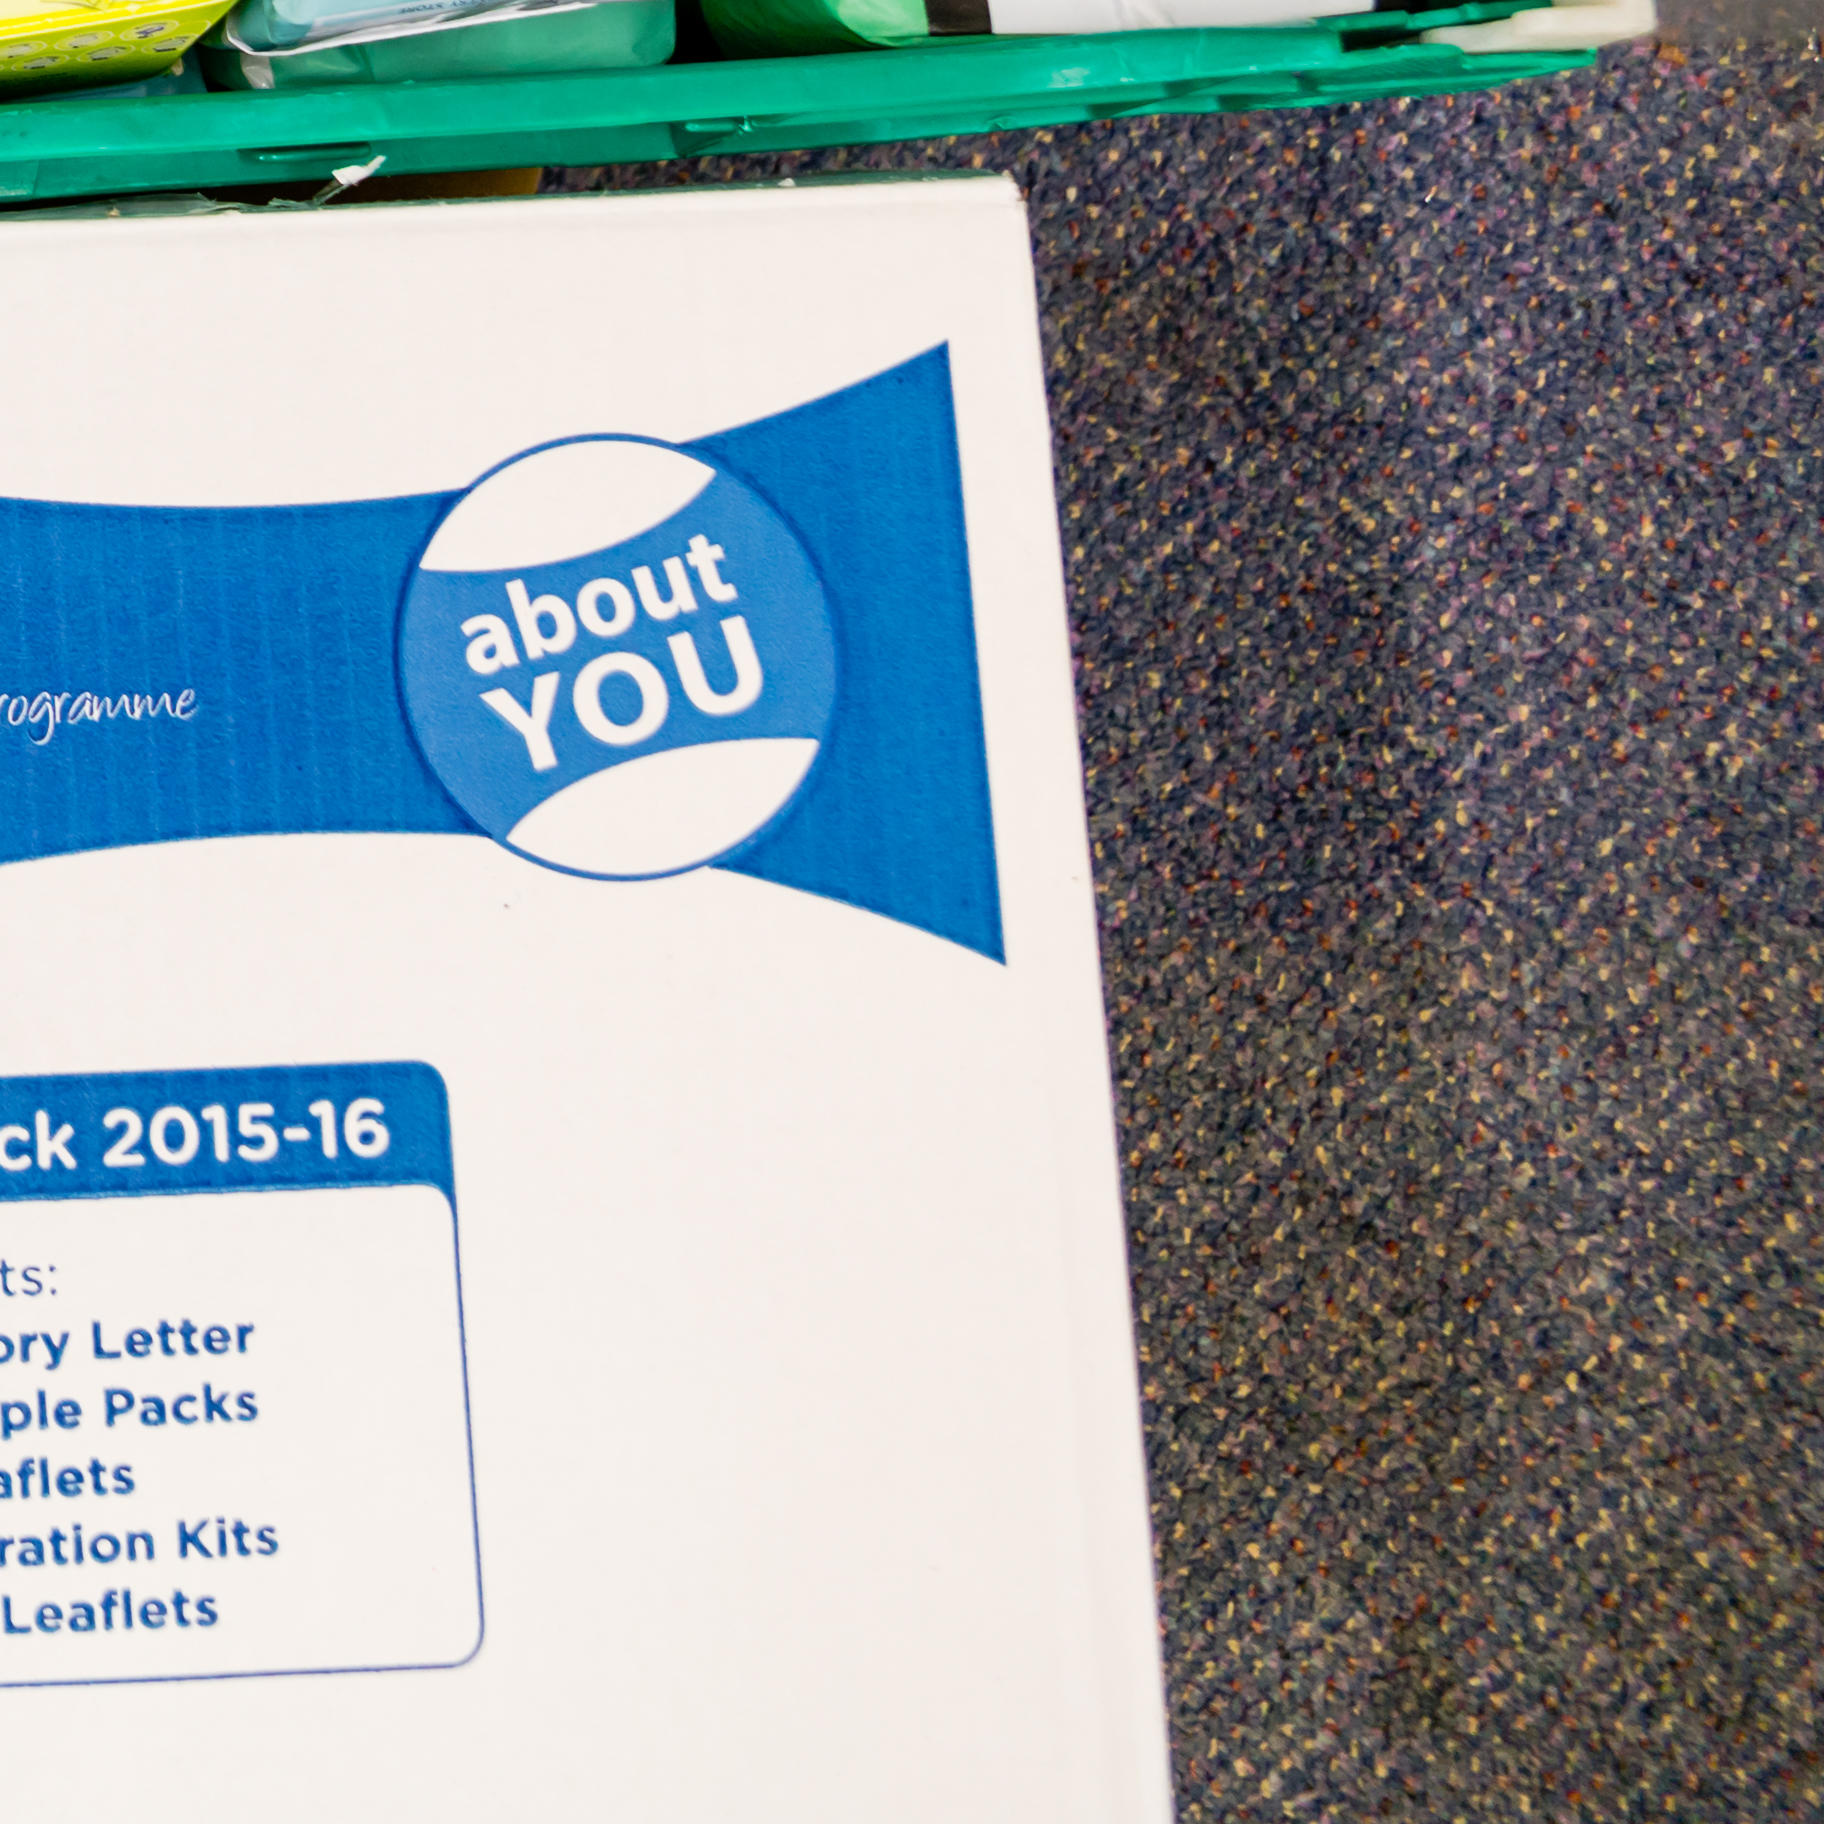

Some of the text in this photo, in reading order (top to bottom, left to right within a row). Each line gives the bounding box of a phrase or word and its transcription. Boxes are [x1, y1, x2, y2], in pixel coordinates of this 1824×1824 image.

[458, 528, 740, 678] about
[475, 615, 769, 778] YOU
[102, 1098, 391, 1170] 2015-16
[92, 1319, 256, 1361] Letter
[103, 1384, 259, 1427] Packs
[177, 1518, 280, 1559] Kits
[2, 1588, 221, 1636] Leaflets
